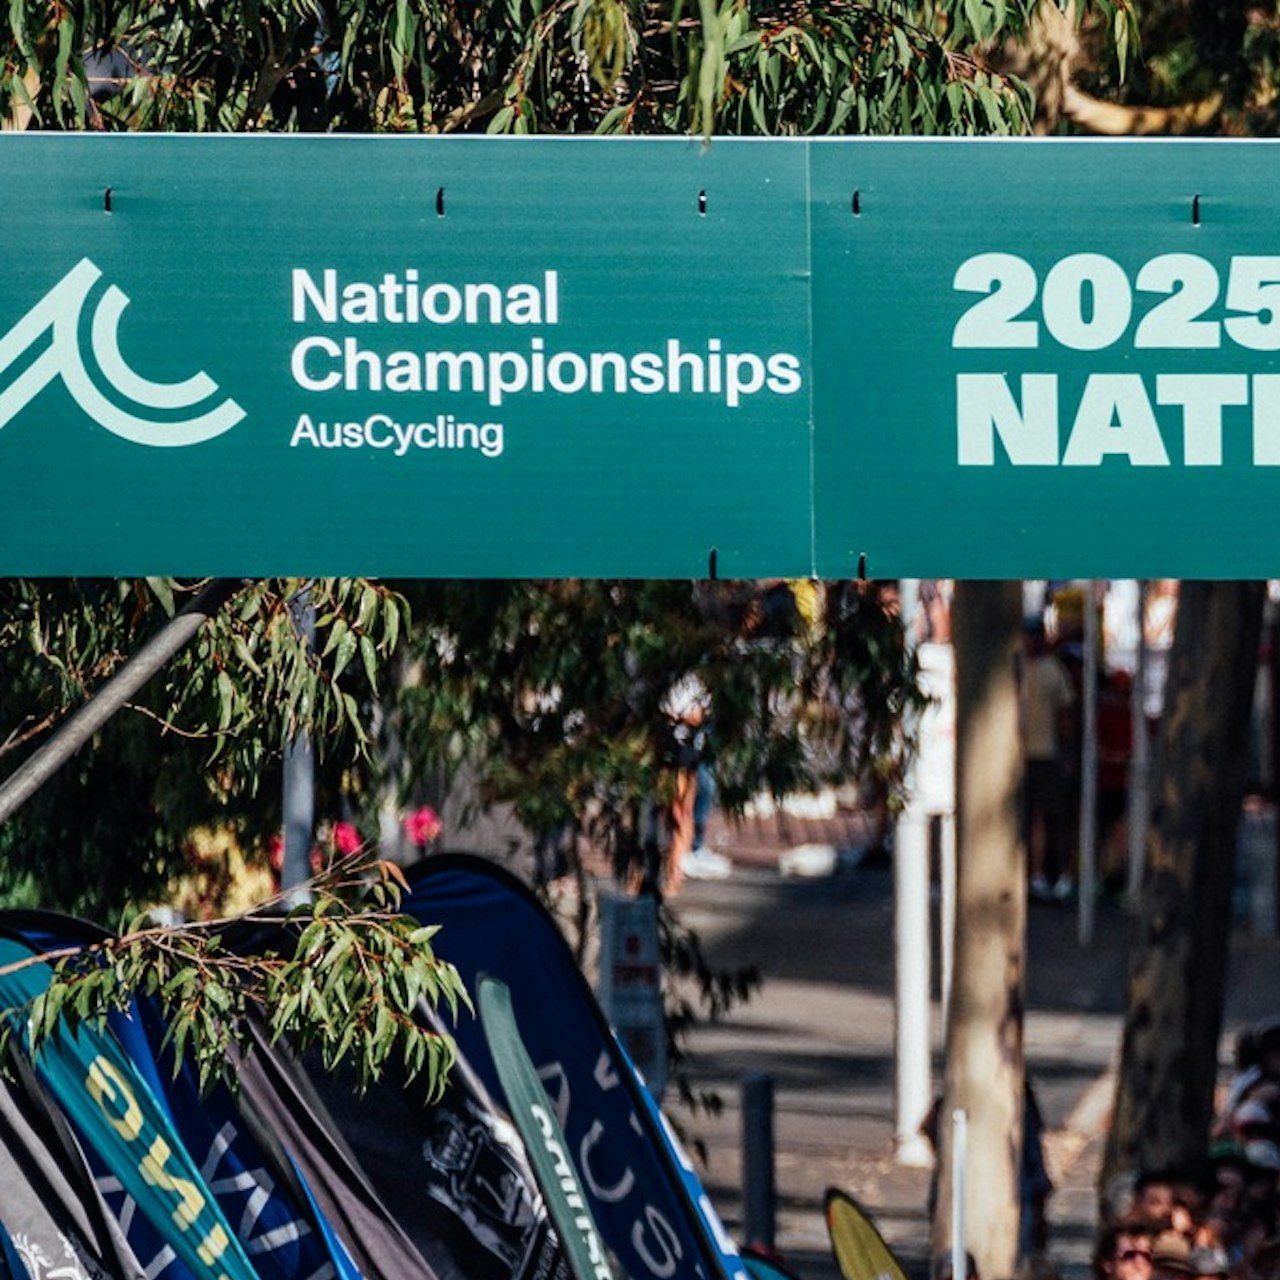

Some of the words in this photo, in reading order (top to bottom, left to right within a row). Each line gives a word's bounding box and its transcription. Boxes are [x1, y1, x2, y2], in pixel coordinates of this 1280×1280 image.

[291, 268, 559, 324] National
[290, 336, 802, 407] Championships
[290, 414, 505, 457] AusCycling
